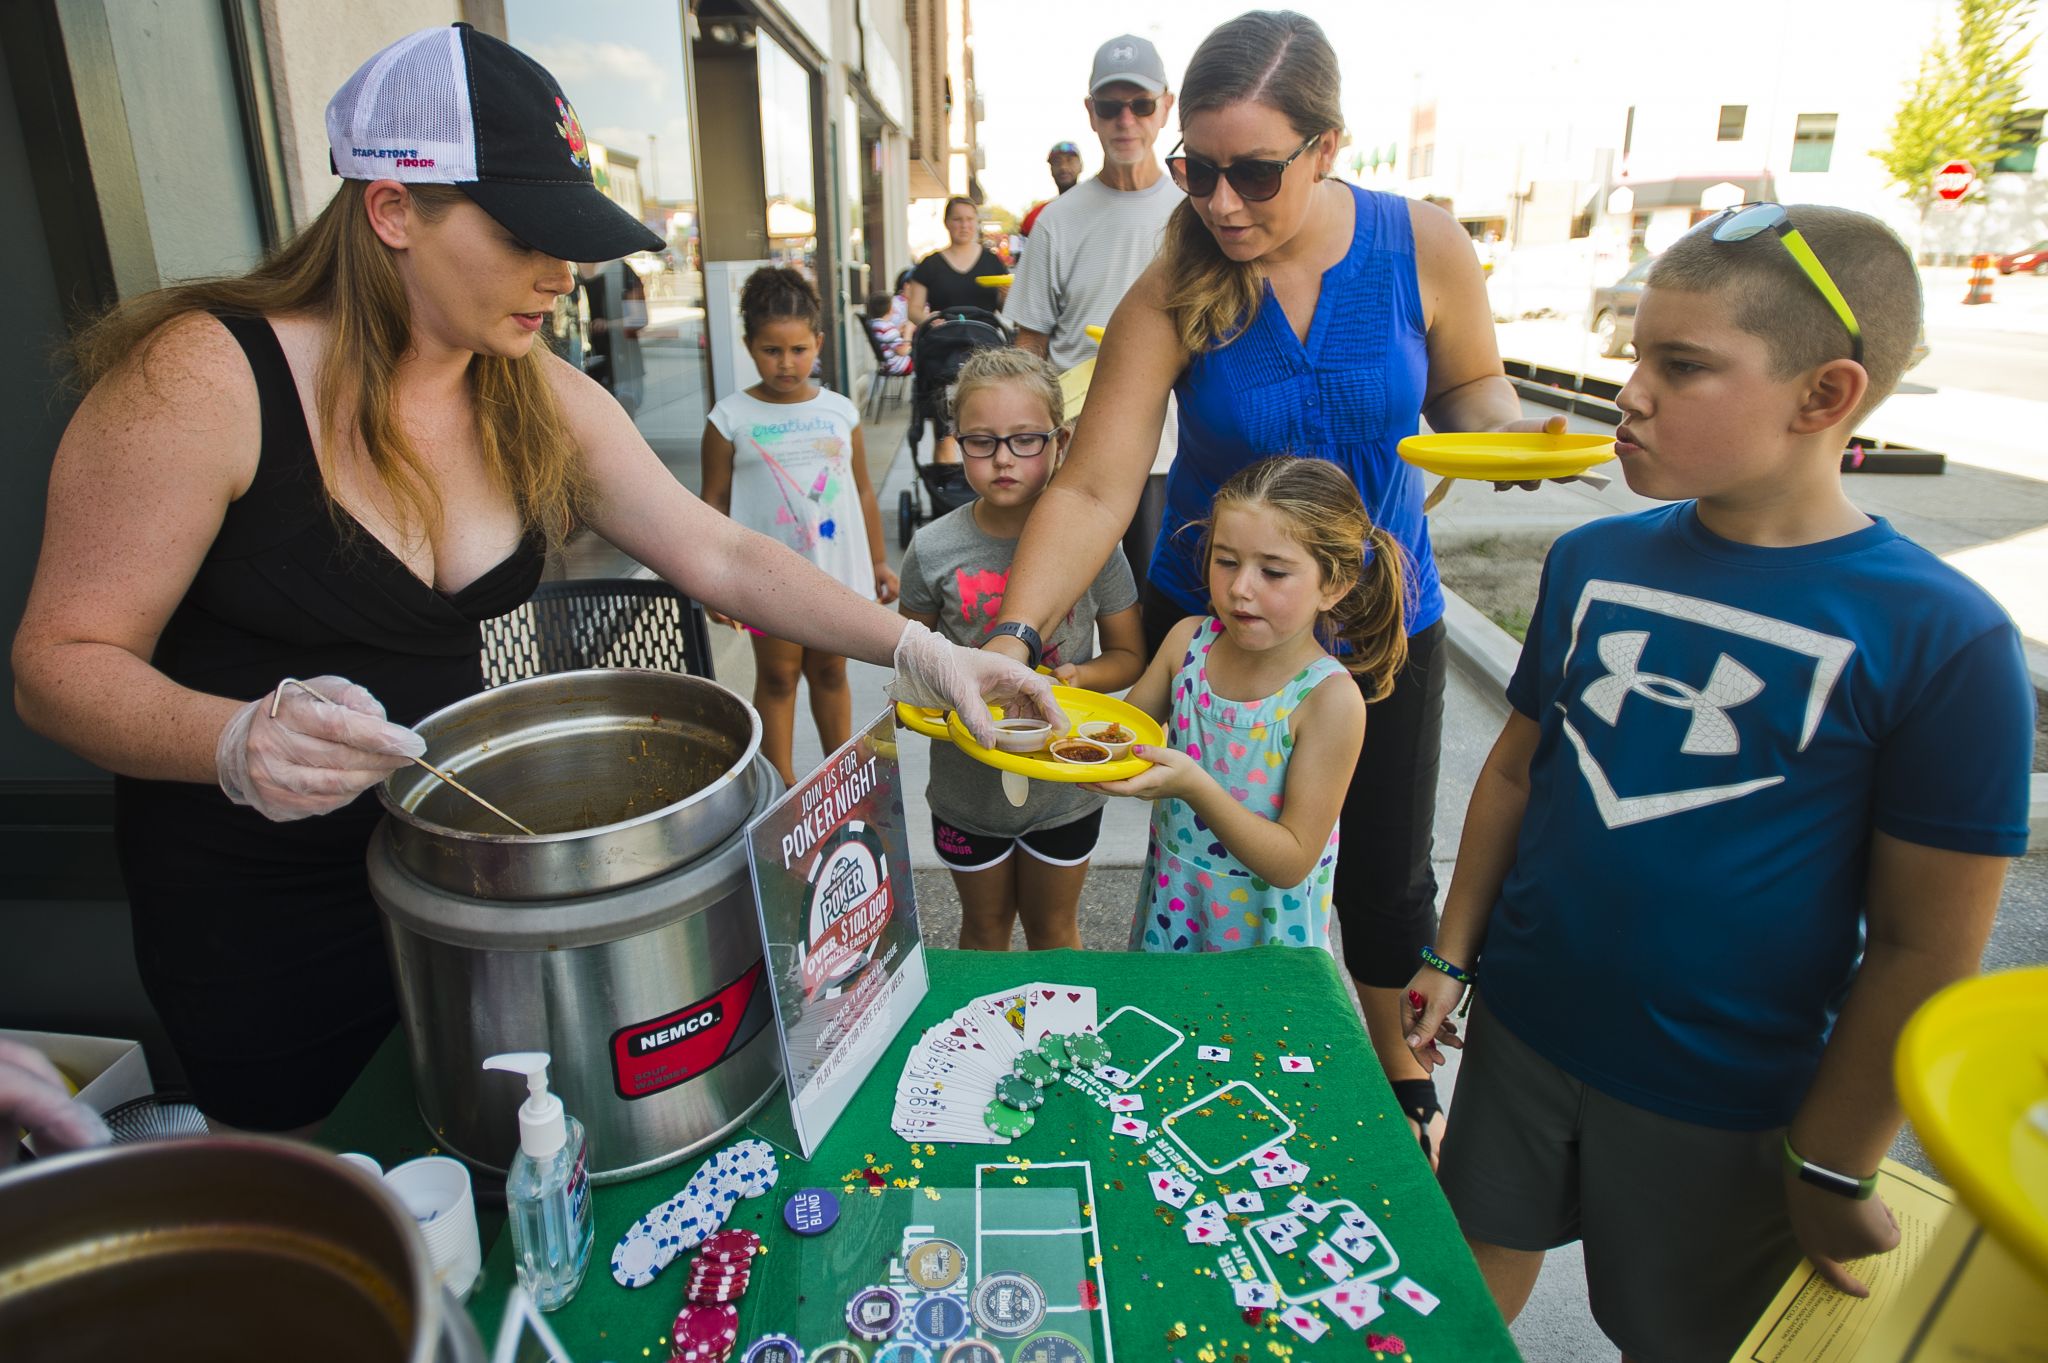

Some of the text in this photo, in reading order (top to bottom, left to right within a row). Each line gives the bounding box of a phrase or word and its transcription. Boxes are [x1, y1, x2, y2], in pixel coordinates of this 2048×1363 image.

[352, 147, 418, 158] STAPLETON'S
[396, 158, 435, 168] FOODS
[752, 416, 835, 438] creativity
[801, 750, 858, 816] JOIN US FOR
[781, 755, 877, 870] POKER NIGHT
[821, 866, 866, 931] POKER
[807, 887, 888, 975] OVER $100,000
[815, 966, 824, 982] IN
[824, 942, 850, 970] PRIZES
[849, 932, 868, 951] EACH
[815, 1001, 850, 1051] AMERICA'S
[856, 972, 877, 998] POKER
[876, 942, 898, 976] LEAGUE
[1030, 990, 1038, 1001] 4
[640, 1012, 713, 1051] NEMCO
[816, 971, 905, 1091] PLAY HERE FOR FREE EVERY WEEK
[943, 1036, 960, 1047] 8
[634, 1065, 668, 1082] SOUP
[635, 1067, 689, 1090] WARMER
[1070, 1065, 1119, 1096] OUEUR
[909, 1098, 928, 1106] 9
[910, 1086, 929, 1095] 2
[1064, 1074, 1110, 1108] PLAYER
[1147, 1129, 1203, 1182] JOUEUR 5
[795, 1193, 809, 1230] LITTLE
[808, 1194, 822, 1226] BLIND
[998, 1288, 1012, 1318] POKER
[931, 1305, 939, 1334] REGIONAL
[1771, 1342, 1789, 1363] SCHOO
